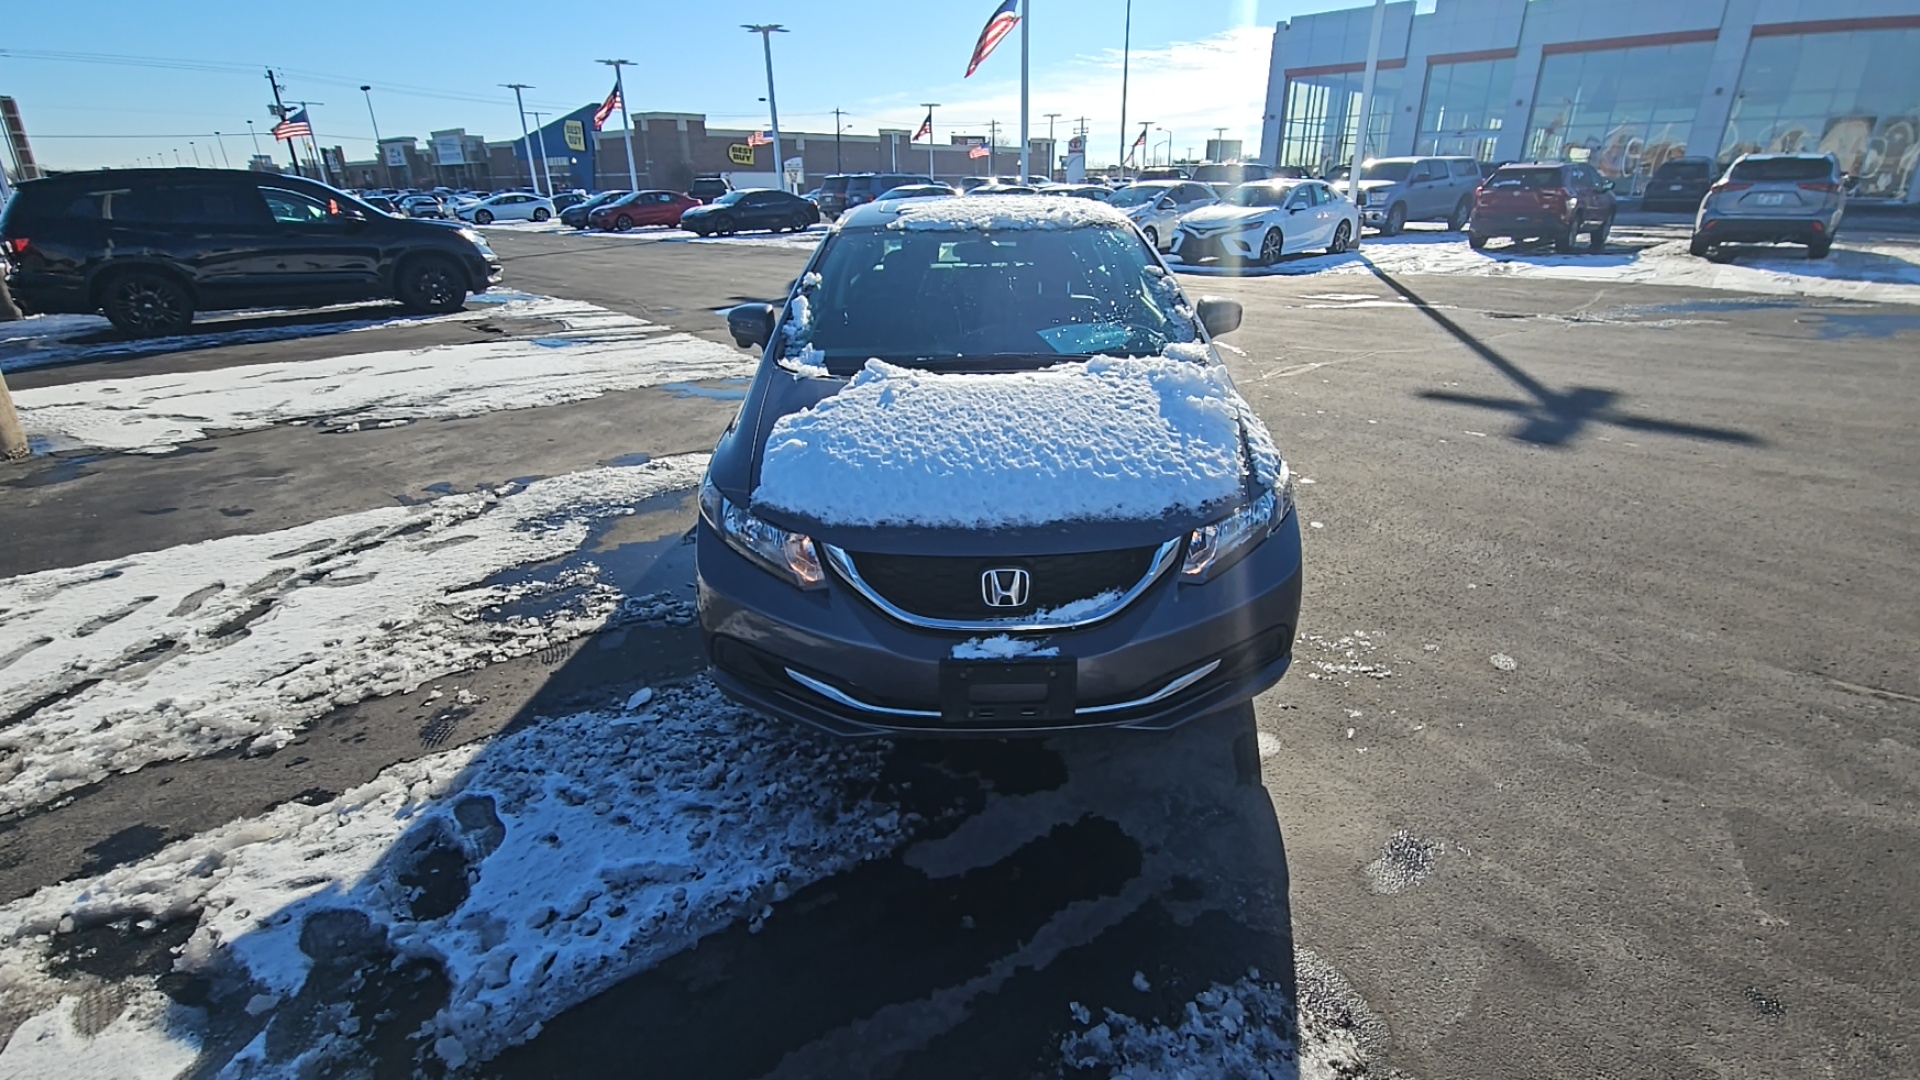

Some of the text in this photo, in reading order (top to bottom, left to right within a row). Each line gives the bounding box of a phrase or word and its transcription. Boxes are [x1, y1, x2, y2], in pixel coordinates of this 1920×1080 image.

[566, 124, 582, 135] BEST
[568, 135, 582, 146] BUY
[731, 146, 752, 155] BEST
[733, 153, 751, 162] BUY
